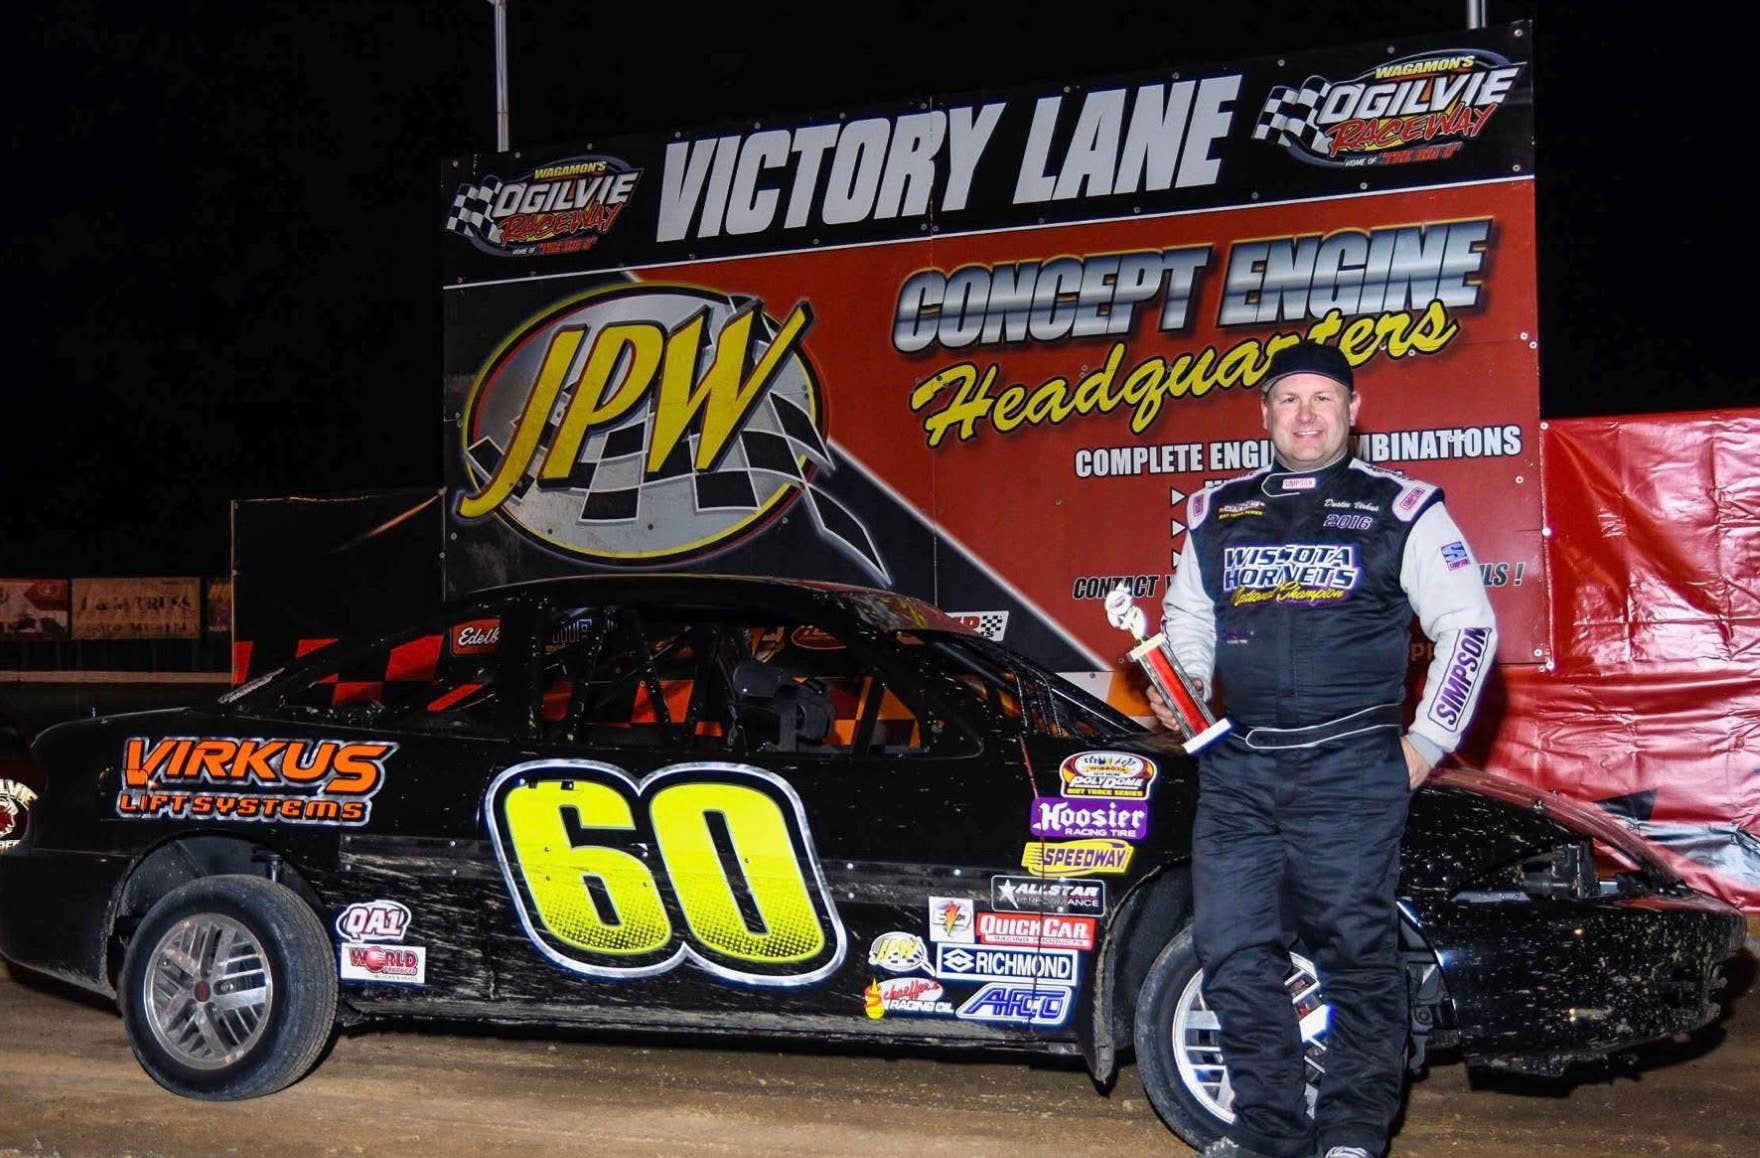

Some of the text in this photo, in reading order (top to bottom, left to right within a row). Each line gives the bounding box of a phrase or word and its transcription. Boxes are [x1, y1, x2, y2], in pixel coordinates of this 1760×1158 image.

[1375, 55, 1475, 80] WAGAMON'S
[1317, 67, 1519, 125] OGILVIE
[1325, 102, 1498, 158] RACEWAY
[533, 160, 608, 180] WAGAMON'S
[655, 74, 1243, 243] VICTORY LANE
[491, 171, 639, 218] OGILVIE
[500, 200, 624, 245] RACEWAY
[891, 217, 1495, 354] CONCEPT ENGINE
[454, 298, 816, 520] JPW
[1074, 424, 1523, 478] COMPLETE ENGI MBINATIONS
[1322, 513, 1374, 531] 2016
[1223, 543, 1353, 570] WISSOTA
[1072, 574, 1161, 600] CONTACT
[1222, 566, 1358, 592] HORNETS
[1275, 580, 1345, 606] Champion
[457, 626, 500, 647] Edelb
[1435, 626, 1488, 727] SIMPSON
[122, 736, 397, 797] VIRKUS
[117, 794, 366, 822] LIFT SYSTEMS
[1032, 801, 1146, 832] Hoosier
[1064, 827, 1137, 838] RACING TIRE
[503, 778, 828, 965] 60
[1044, 847, 1126, 868] SPEEDWAY
[1014, 882, 1100, 898] ALLSTAR
[345, 906, 403, 940] QA1
[349, 945, 419, 974] WORLD
[975, 953, 1071, 979] RICHMOND
[889, 999, 955, 1014] RACING OIL
[967, 987, 1066, 1017] AFCO
